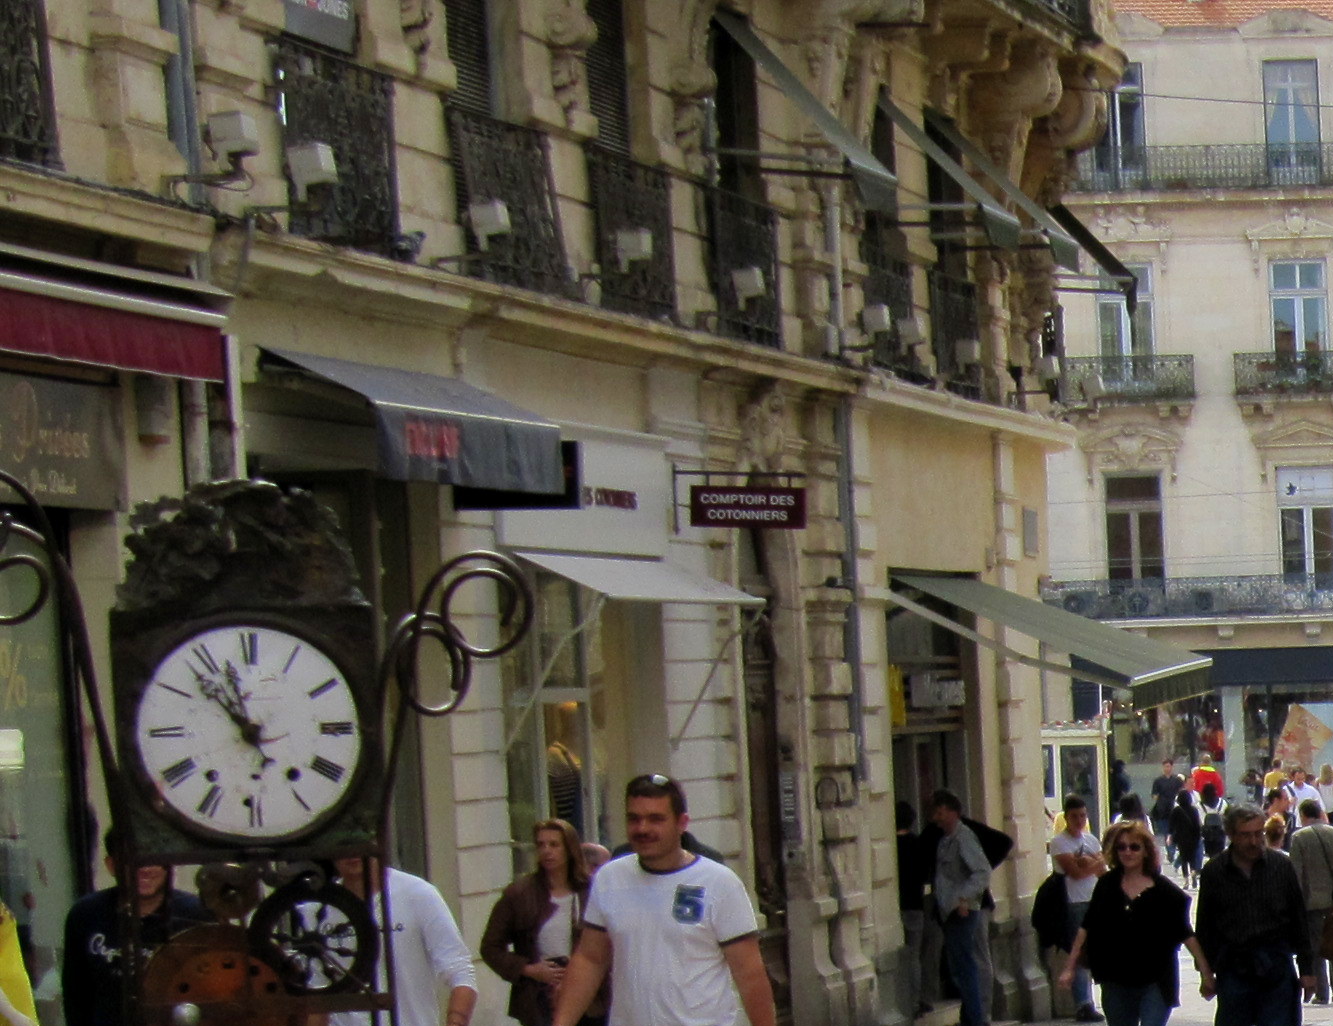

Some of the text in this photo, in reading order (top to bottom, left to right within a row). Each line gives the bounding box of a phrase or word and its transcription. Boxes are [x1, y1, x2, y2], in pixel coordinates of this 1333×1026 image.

[700, 493, 796, 506] COMPTOIR DES
[707, 509, 788, 521] COTONNIERS
[672, 883, 706, 925] 5
